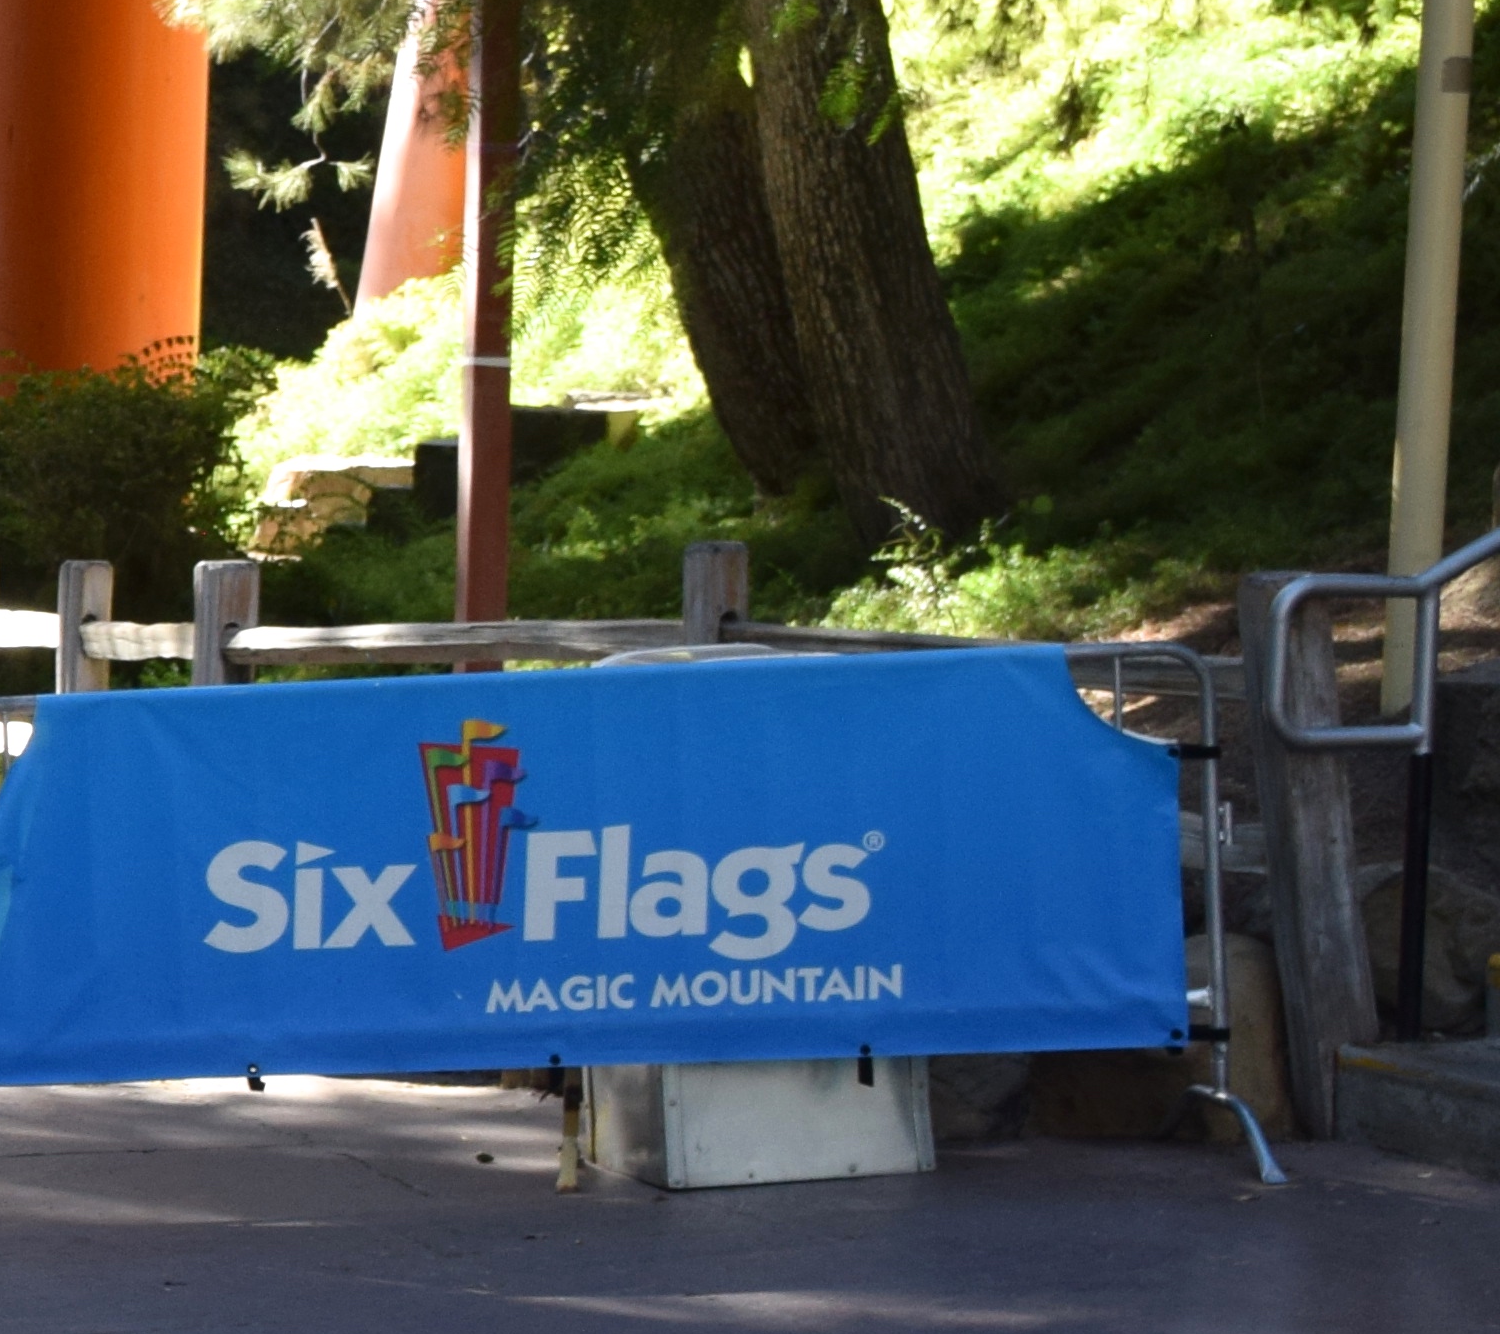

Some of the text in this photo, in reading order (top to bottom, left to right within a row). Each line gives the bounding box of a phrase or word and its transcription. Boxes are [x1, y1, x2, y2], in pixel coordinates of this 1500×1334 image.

[202, 839, 418, 955] Six
[484, 963, 903, 1014] MAGIC MOUNTAIN
